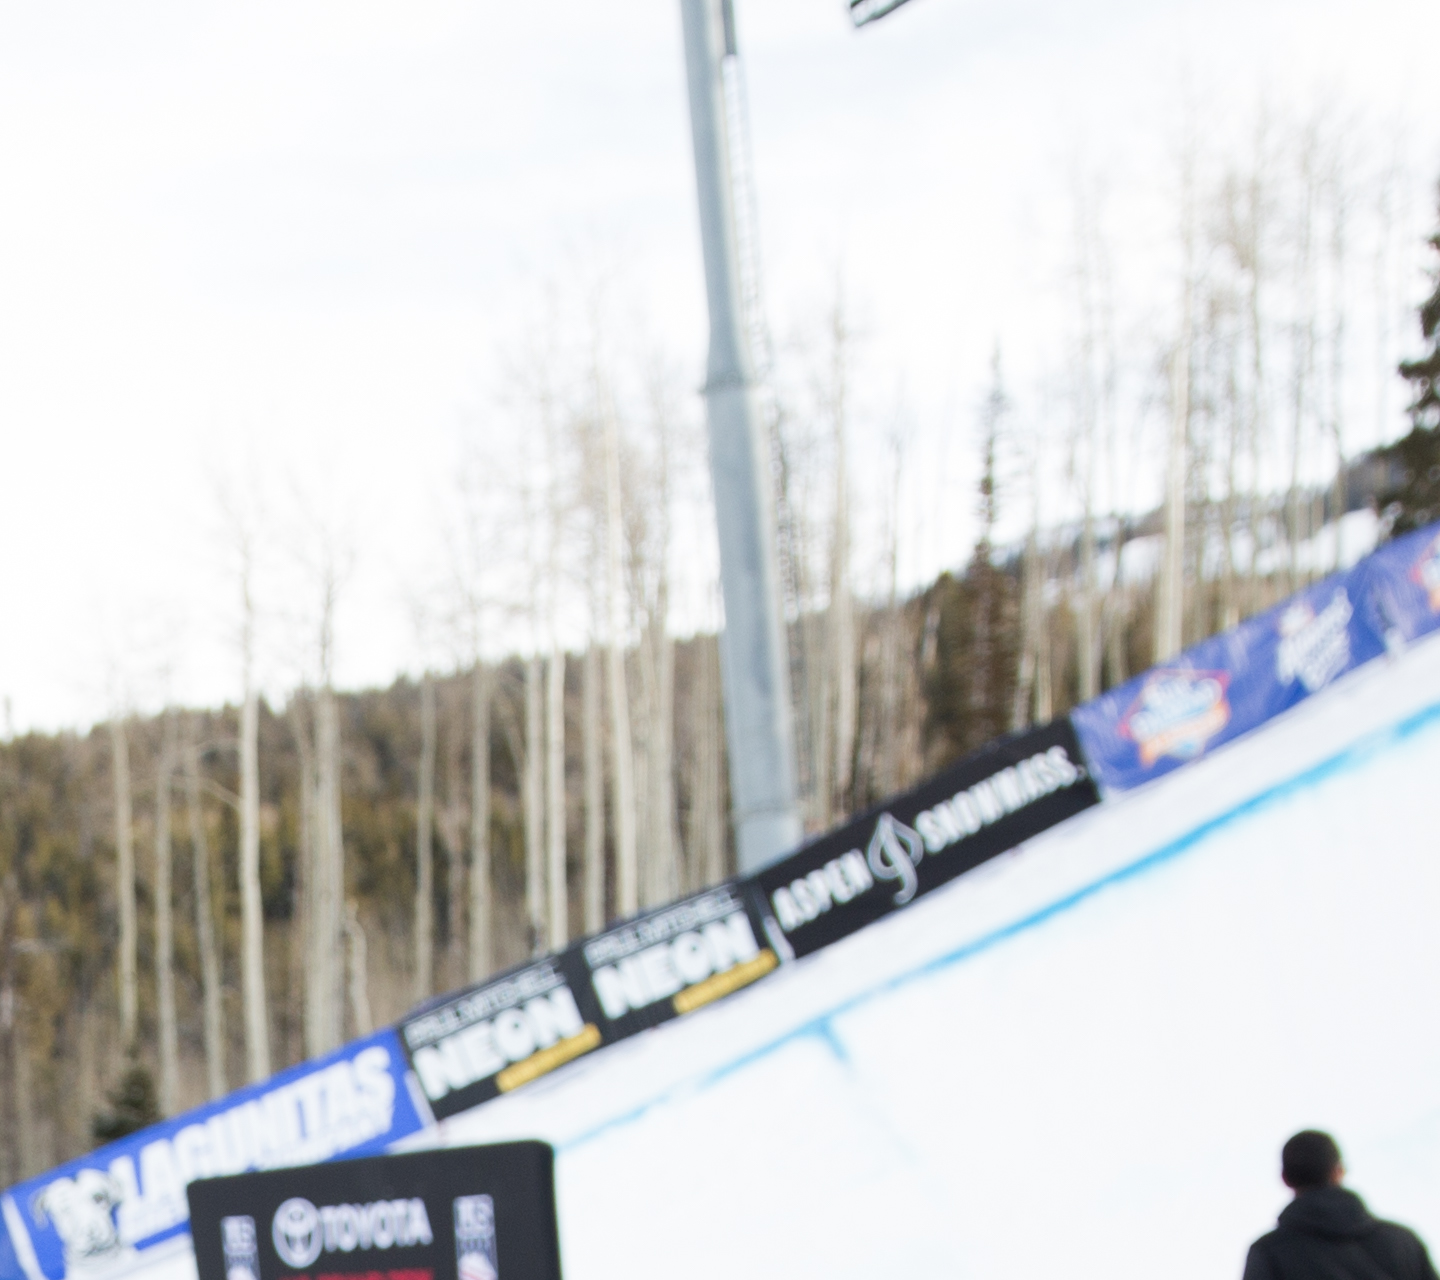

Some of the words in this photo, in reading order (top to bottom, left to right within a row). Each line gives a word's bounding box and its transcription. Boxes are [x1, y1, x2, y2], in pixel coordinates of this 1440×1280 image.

[771, 848, 876, 934] ASPEN
[915, 745, 1081, 855] SNOWMASS
[591, 910, 761, 1020] NEON
[413, 983, 583, 1101] NEON
[108, 1045, 397, 1206] LAGUNITAS
[320, 1197, 434, 1253] TOYOTA
